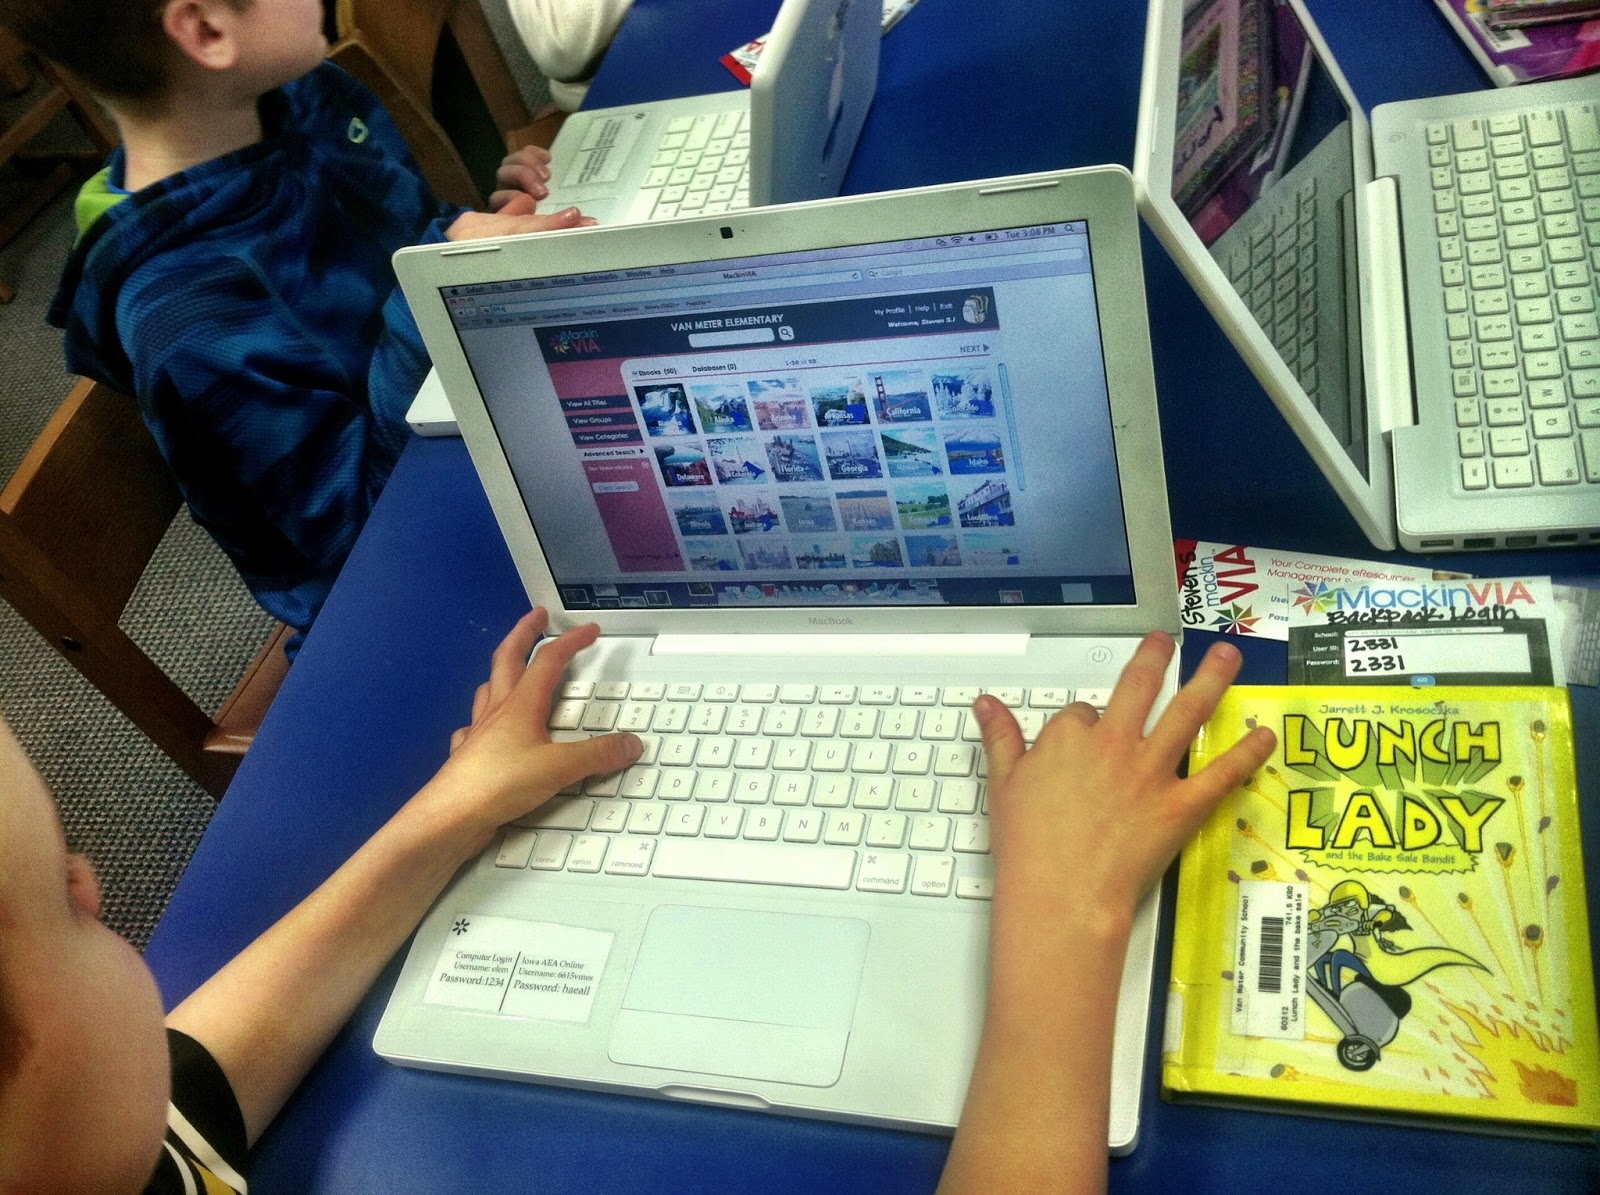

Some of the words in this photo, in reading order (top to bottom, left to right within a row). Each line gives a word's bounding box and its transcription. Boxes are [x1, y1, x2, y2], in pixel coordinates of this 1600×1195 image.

[1005, 230, 1021, 239] Tue
[1043, 226, 1056, 236] PM
[659, 267, 676, 276] Help
[874, 308, 884, 317] My
[885, 306, 906, 314] Profile
[914, 304, 930, 313] Help
[939, 302, 954, 310] Exit
[671, 322, 693, 333] VAN
[697, 319, 723, 331] METER
[726, 313, 784, 328] ELEMENTARY
[571, 338, 601, 354] VIA
[960, 345, 980, 354] NEXT
[887, 406, 922, 416] California
[589, 417, 612, 425] Groups
[595, 433, 629, 441] Categories
[584, 450, 614, 458] Advanced
[615, 449, 636, 457] Search
[968, 457, 989, 467] Idaho
[841, 464, 869, 474] Georgia
[1270, 557, 1292, 568] Your
[1294, 560, 1349, 574] Complete
[1213, 545, 1259, 604] VIA
[1266, 567, 1341, 583] Management
[1199, 555, 1220, 607] mackin
[1181, 566, 1206, 625] Steven
[1335, 580, 1536, 610] MackinVIA
[808, 615, 854, 626] MacBook
[1313, 631, 1339, 639] School:
[1347, 636, 1399, 653] 2331
[1305, 658, 1339, 666] Password:
[1349, 654, 1406, 673] 2331
[1318, 703, 1367, 714] Jarrett
[1371, 704, 1385, 715] J.
[1389, 704, 1460, 716] Krosoczka
[1283, 713, 1501, 773] LUNCH
[675, 745, 682, 753] E
[711, 746, 719, 754] R
[751, 746, 757, 755] T
[788, 748, 795, 757] Y
[826, 749, 835, 759] U
[672, 778, 681, 788] D
[710, 779, 718, 789] F
[749, 781, 757, 791] G
[787, 782, 797, 793] H
[869, 785, 878, 796] K
[758, 817, 767, 827] B
[798, 819, 808, 829] N
[1285, 788, 1506, 852] LADY
[837, 821, 850, 832] M
[1325, 848, 1343, 860] and
[1346, 850, 1364, 861] the
[1366, 850, 1393, 863] Bake
[1395, 852, 1419, 863] Sale
[1421, 853, 1456, 865] Bandit
[610, 860, 644, 869] command
[861, 875, 900, 886] command
[921, 879, 946, 890] option
[1240, 895, 1248, 921] School
[1294, 914, 1302, 934] bake
[1238, 924, 1247, 966] Community
[455, 950, 491, 962] Computer
[491, 953, 513, 965] Login
[520, 956, 540, 965] Iowa
[540, 958, 558, 968] AEA
[559, 960, 585, 970] Online
[453, 961, 490, 973] Username:
[491, 965, 509, 974] elem
[438, 972, 505, 987] Password:1234
[517, 967, 556, 978] Username:
[556, 971, 593, 982] 6615vmes
[512, 979, 561, 993] Password:
[561, 984, 591, 996] haeall
[1236, 971, 1244, 996] Meter
[1291, 974, 1300, 994] Lady
[1235, 997, 1243, 1012] Van
[1290, 997, 1298, 1022] Lunch
